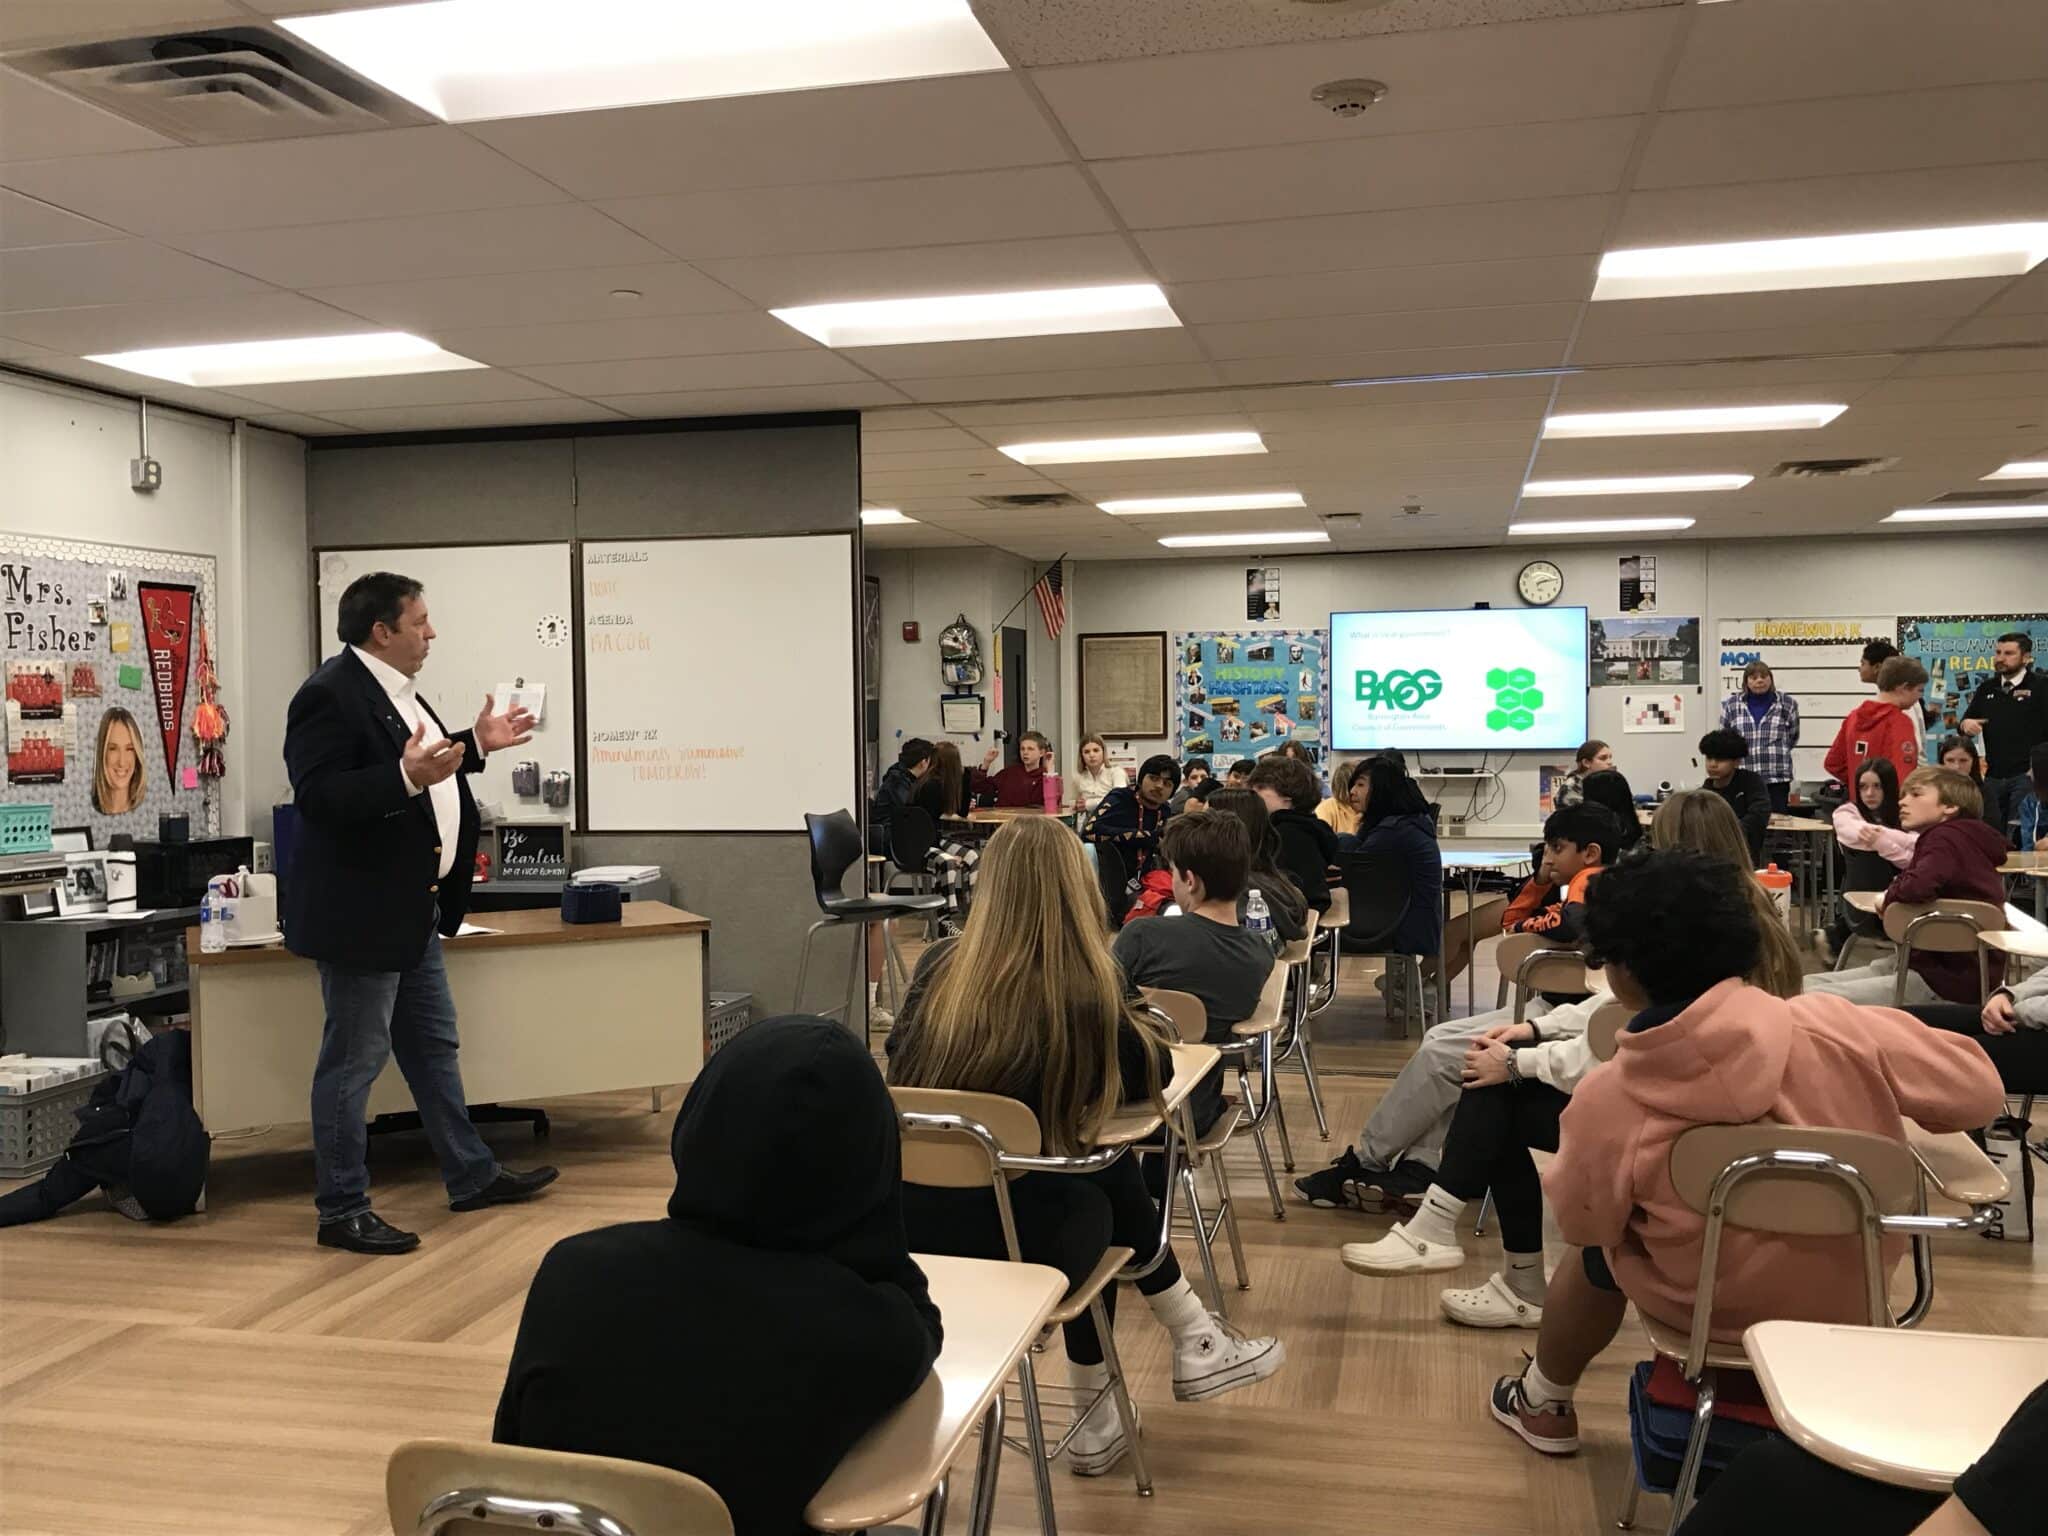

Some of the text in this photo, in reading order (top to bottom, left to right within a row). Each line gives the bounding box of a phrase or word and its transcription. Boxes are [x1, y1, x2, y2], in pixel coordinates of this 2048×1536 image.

[587, 552, 648, 564] MATERIALS
[1, 564, 72, 606] Mrs.
[588, 614, 634, 625] AGENDA
[5, 611, 97, 652] Fisher
[1753, 622, 1862, 638] HOMEWORK
[1720, 651, 1760, 666] MON
[1215, 667, 1285, 681] HISTORY
[153, 648, 175, 731] REDBIRDS
[1722, 676, 1743, 690] TU
[503, 829, 528, 848] Be
